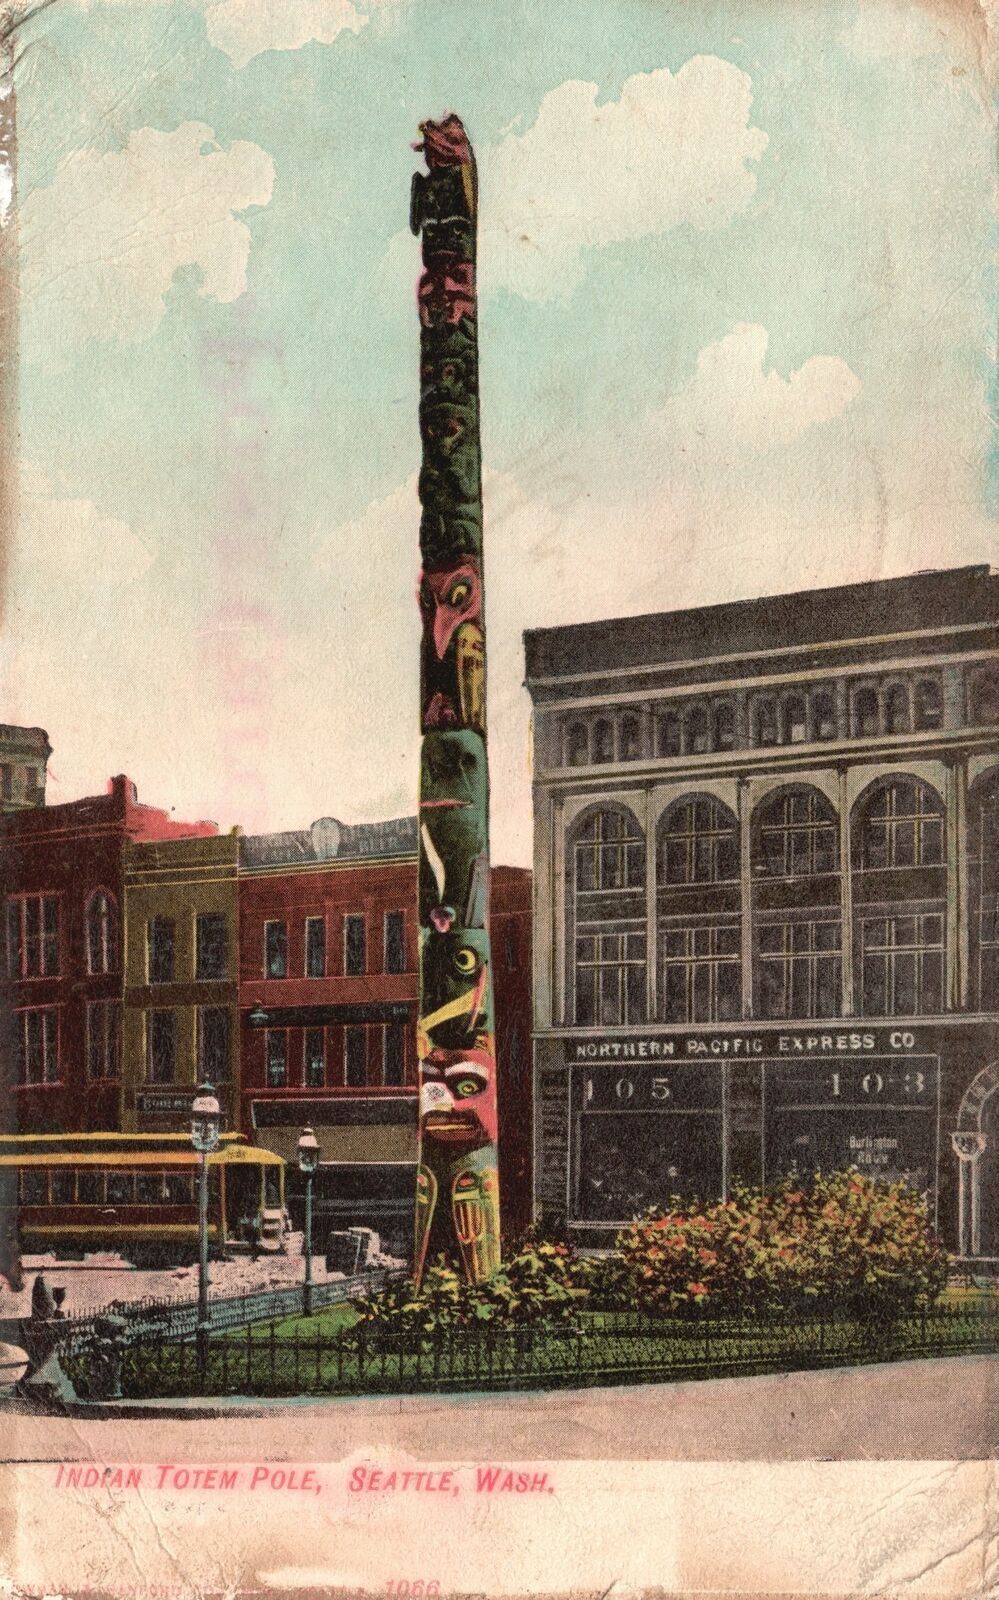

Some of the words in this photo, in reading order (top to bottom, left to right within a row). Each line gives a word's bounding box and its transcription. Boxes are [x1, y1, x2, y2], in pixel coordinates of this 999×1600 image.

[577, 1041, 674, 1057] NORTHERN
[779, 1034, 875, 1051] EXPRESS
[889, 1031, 915, 1049] CO
